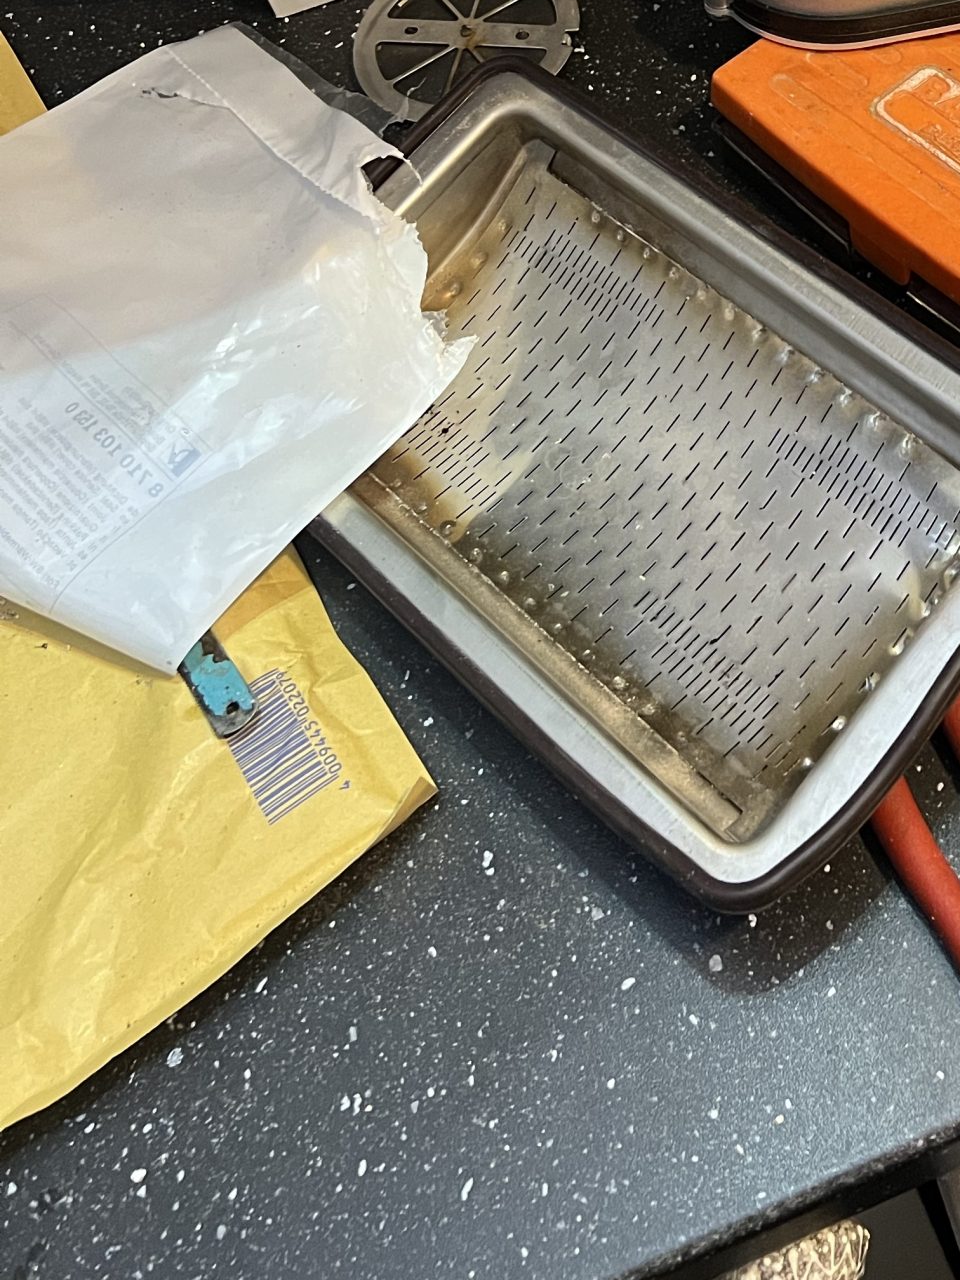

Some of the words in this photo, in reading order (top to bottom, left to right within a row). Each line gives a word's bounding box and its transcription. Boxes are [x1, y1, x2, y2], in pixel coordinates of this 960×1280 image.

[275, 670, 310, 718] 022079
[303, 719, 342, 775] 009445
[339, 780, 351, 791] 4
